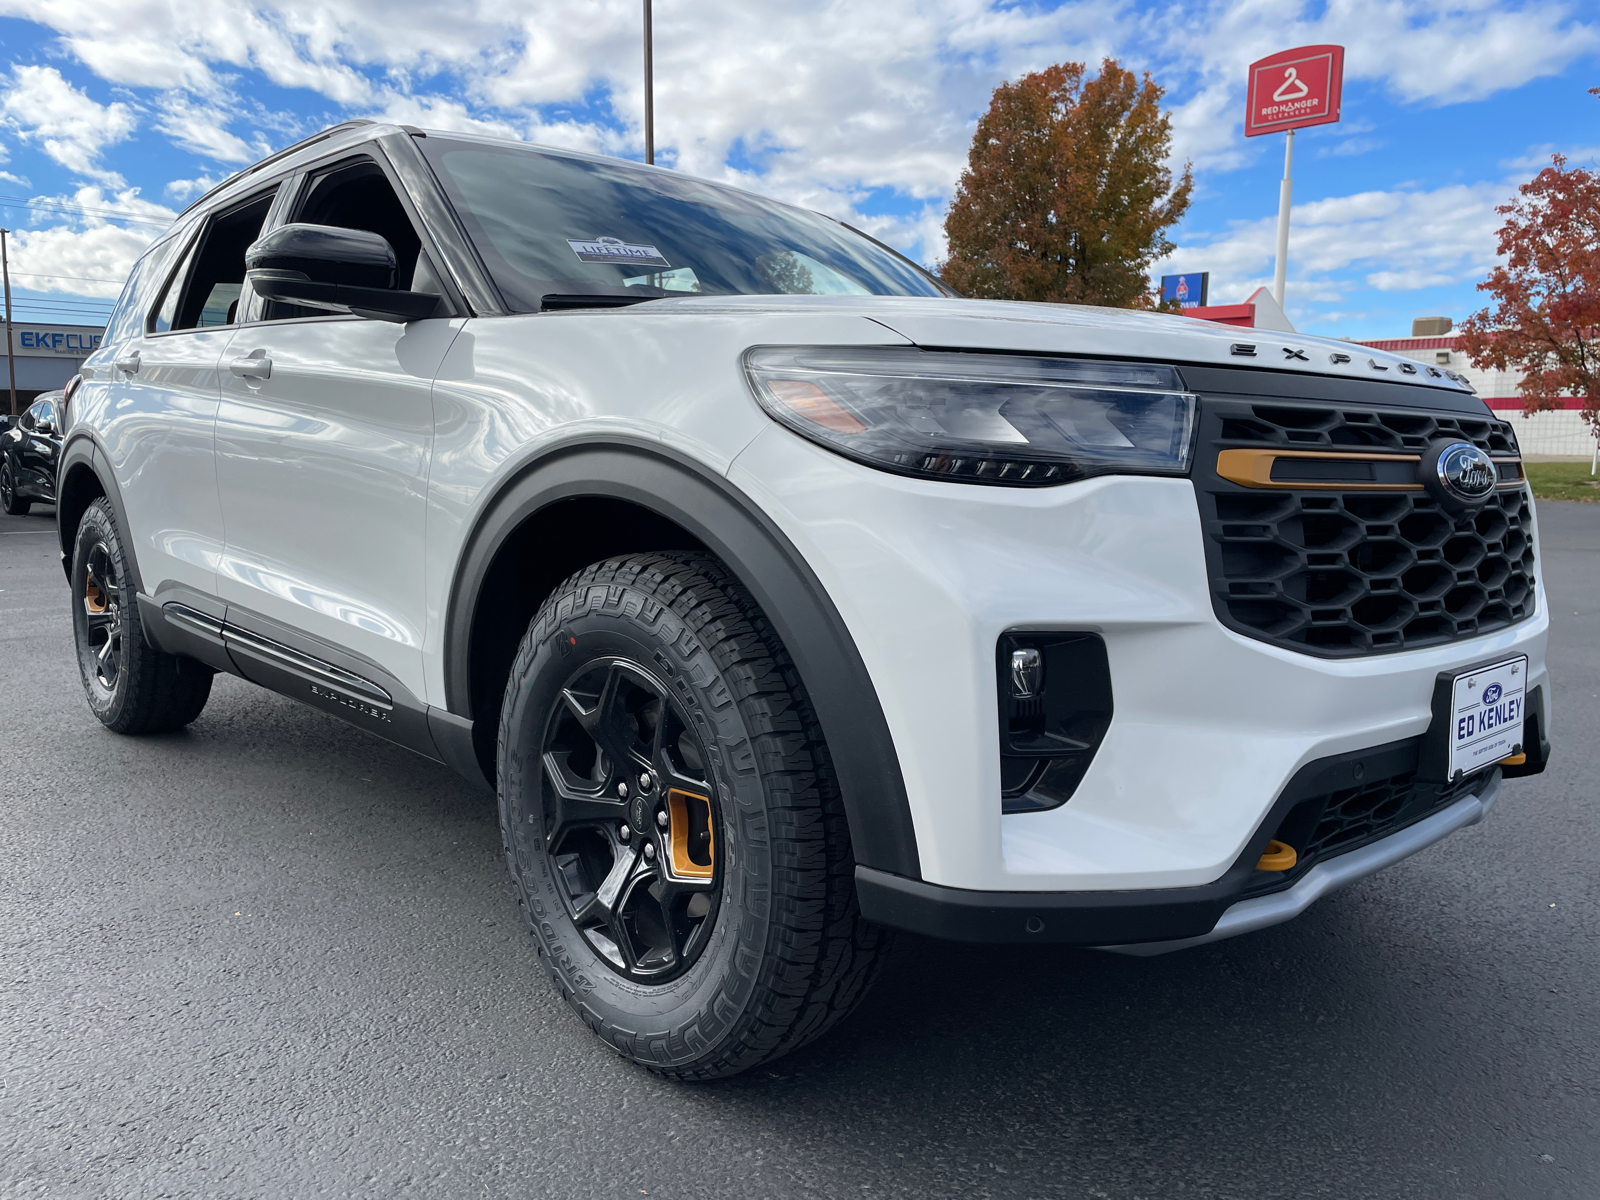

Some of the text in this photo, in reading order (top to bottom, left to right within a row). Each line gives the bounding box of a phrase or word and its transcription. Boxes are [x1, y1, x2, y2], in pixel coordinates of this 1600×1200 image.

[1261, 98, 1319, 116] RED HANGER
[1268, 108, 1311, 120] CLEANERS
[582, 245, 651, 257] LIFETIME
[1458, 454, 1491, 489] Ford
[1457, 697, 1522, 741] ED KENLEY
[509, 746, 597, 996] BRIDGESTONE
